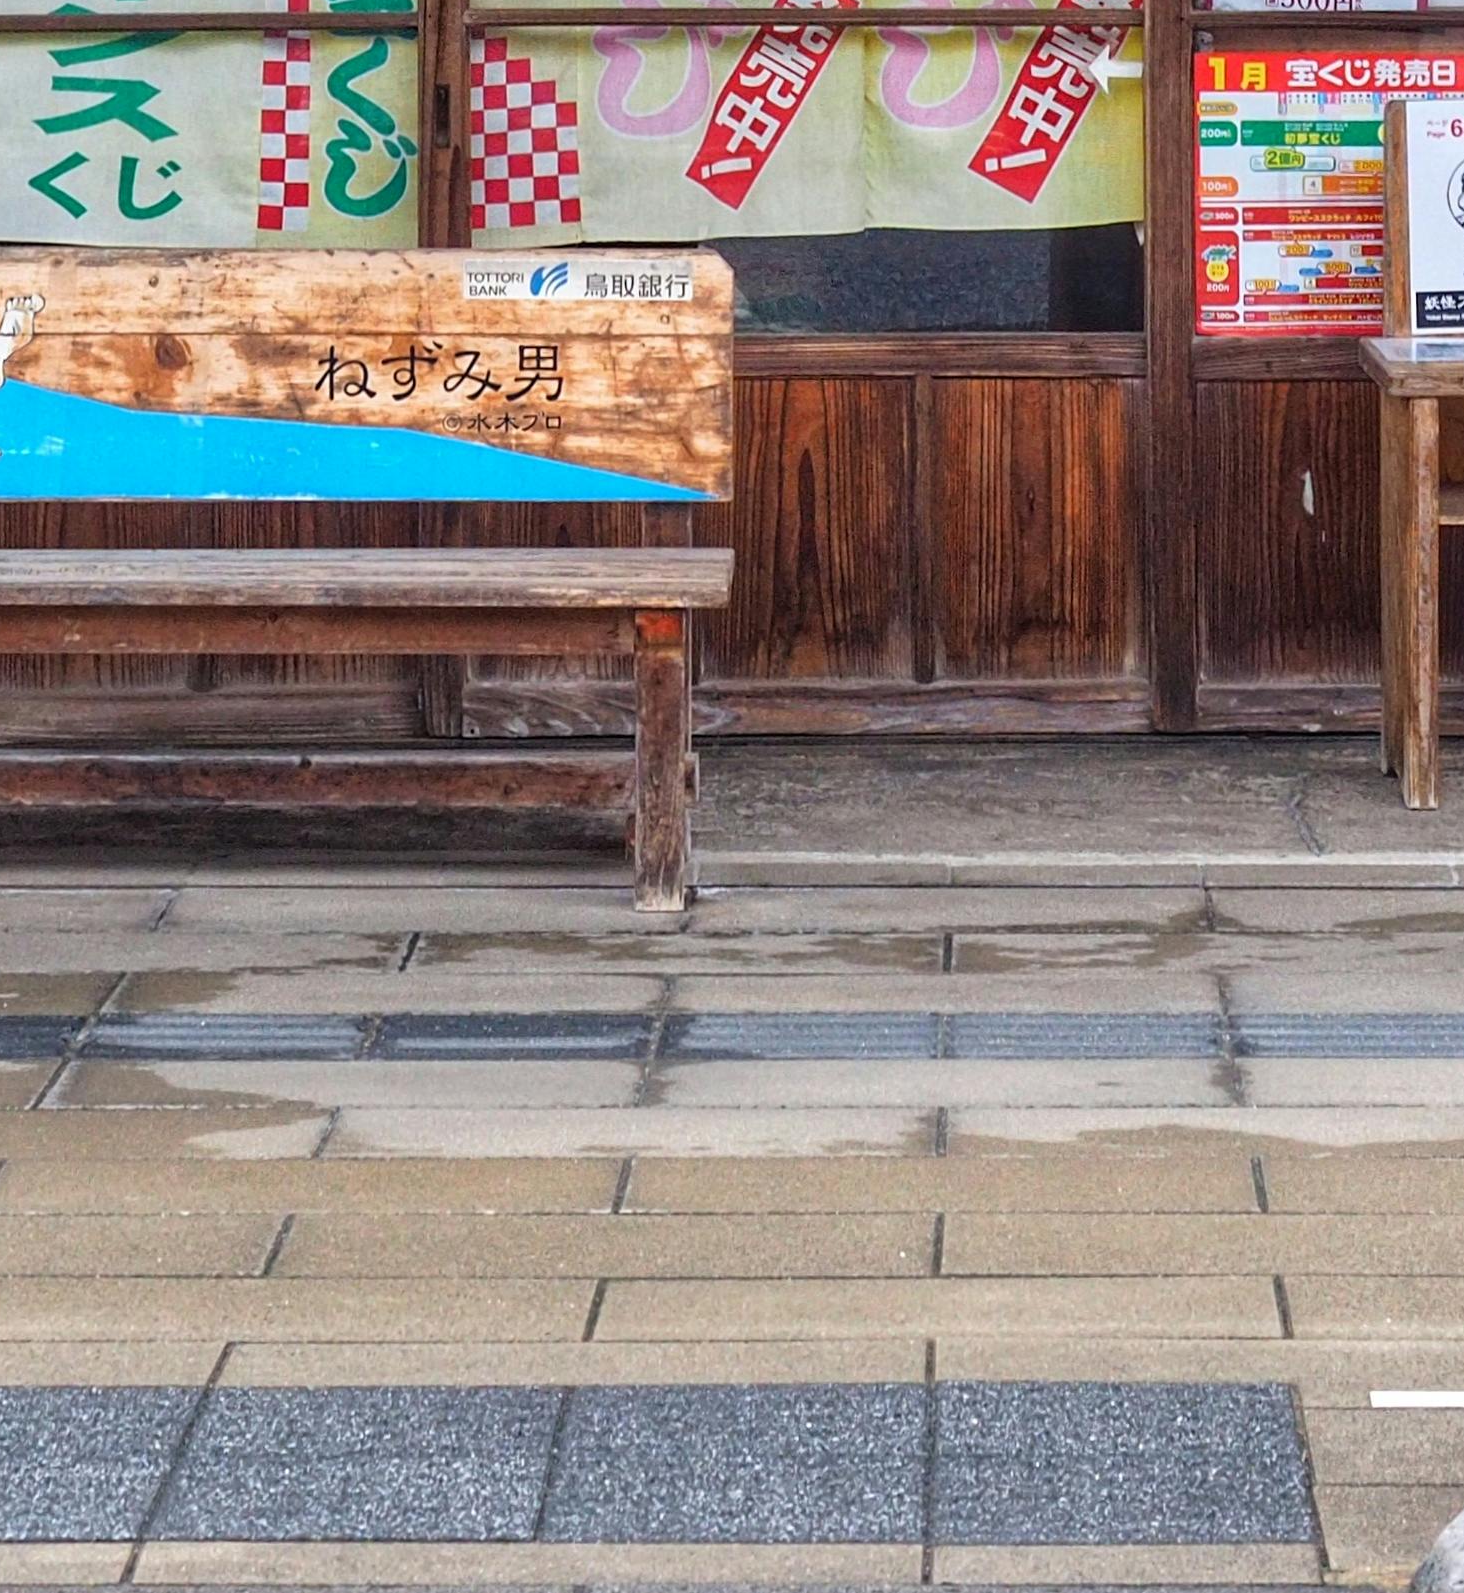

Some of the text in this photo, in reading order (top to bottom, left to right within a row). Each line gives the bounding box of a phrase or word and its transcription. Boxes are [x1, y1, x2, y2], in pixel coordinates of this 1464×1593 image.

[1208, 56, 1456, 91] 1月 宝くじ発売日
[467, 271, 525, 284] TOTTORI
[583, 273, 691, 299] 鳥取銀行
[468, 285, 508, 297] BANK
[313, 340, 564, 403] ねずみ男
